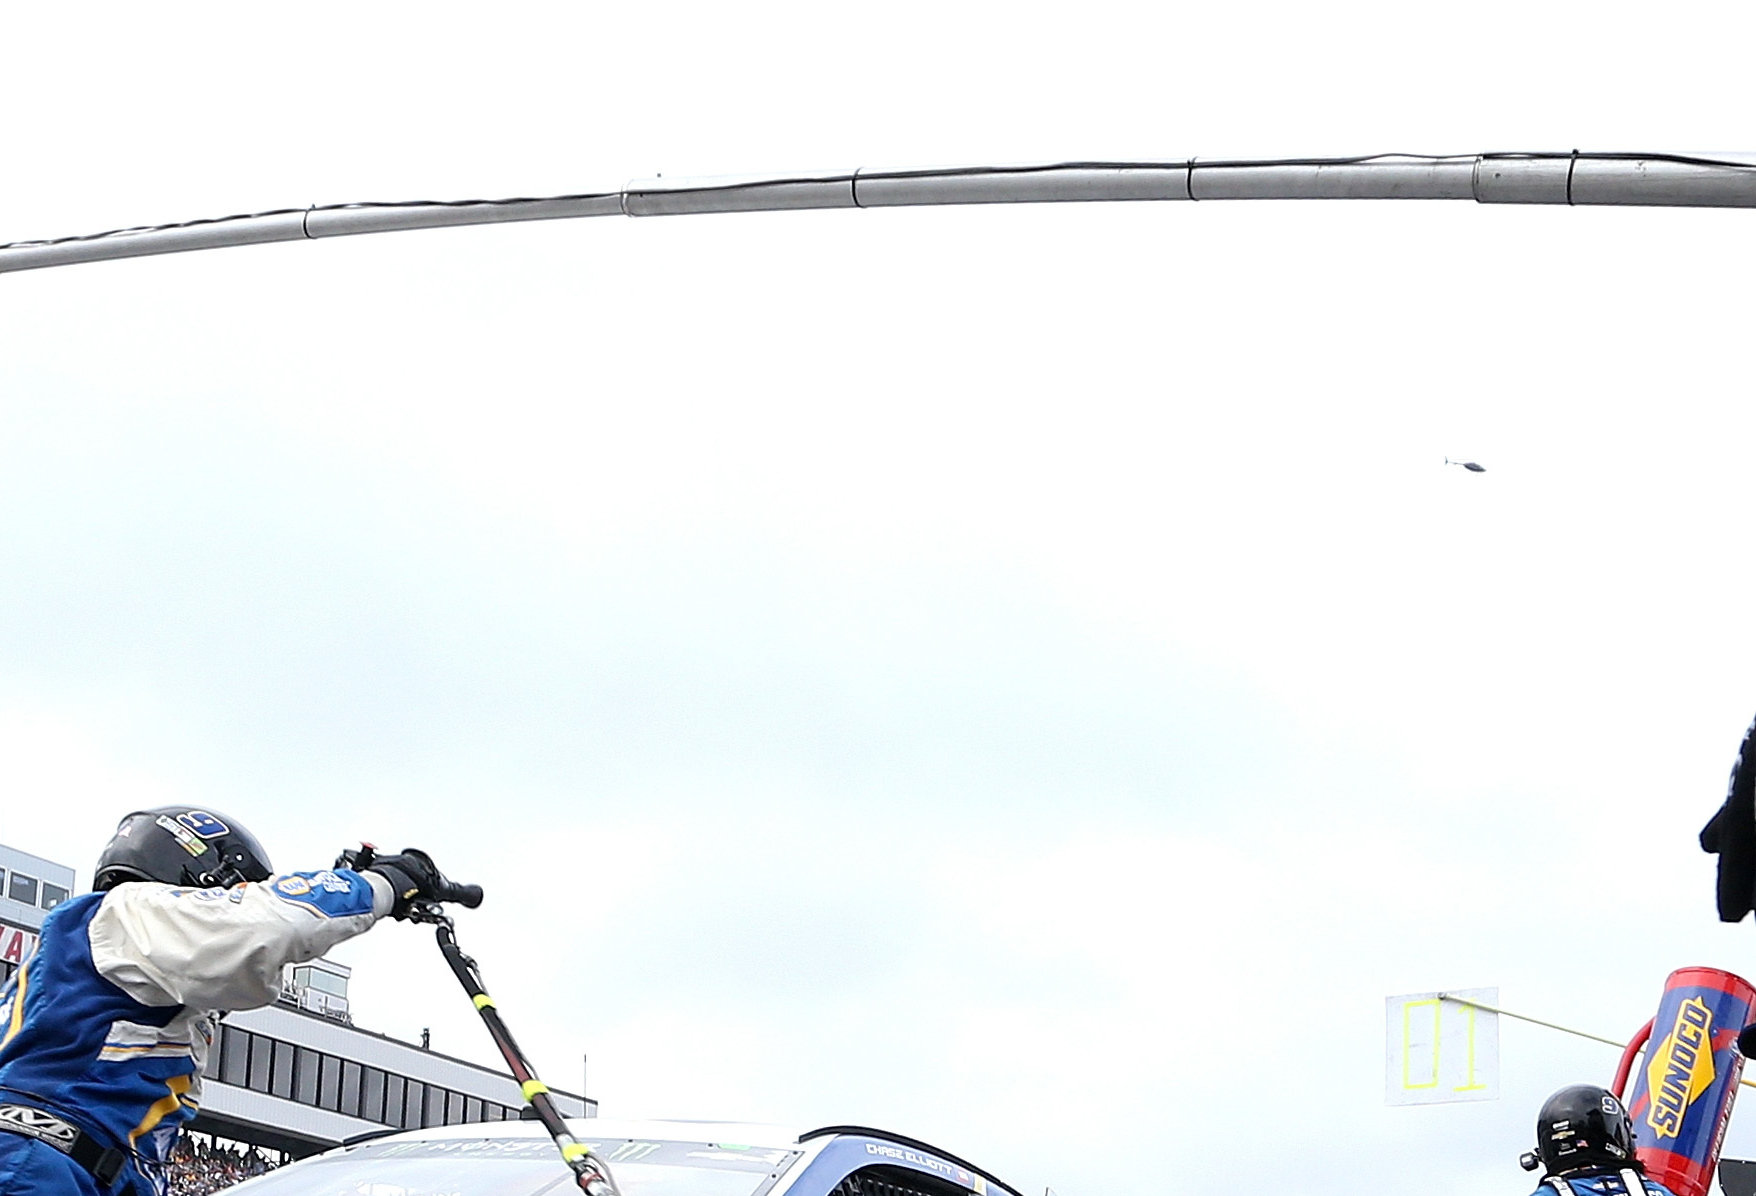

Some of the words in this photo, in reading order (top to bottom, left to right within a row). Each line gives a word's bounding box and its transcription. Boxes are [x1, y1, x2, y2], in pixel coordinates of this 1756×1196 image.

[1653, 1004, 1707, 1132] SUNOCO
[866, 1144, 904, 1160] CHASE
[905, 1151, 952, 1174] ELLIOTT
